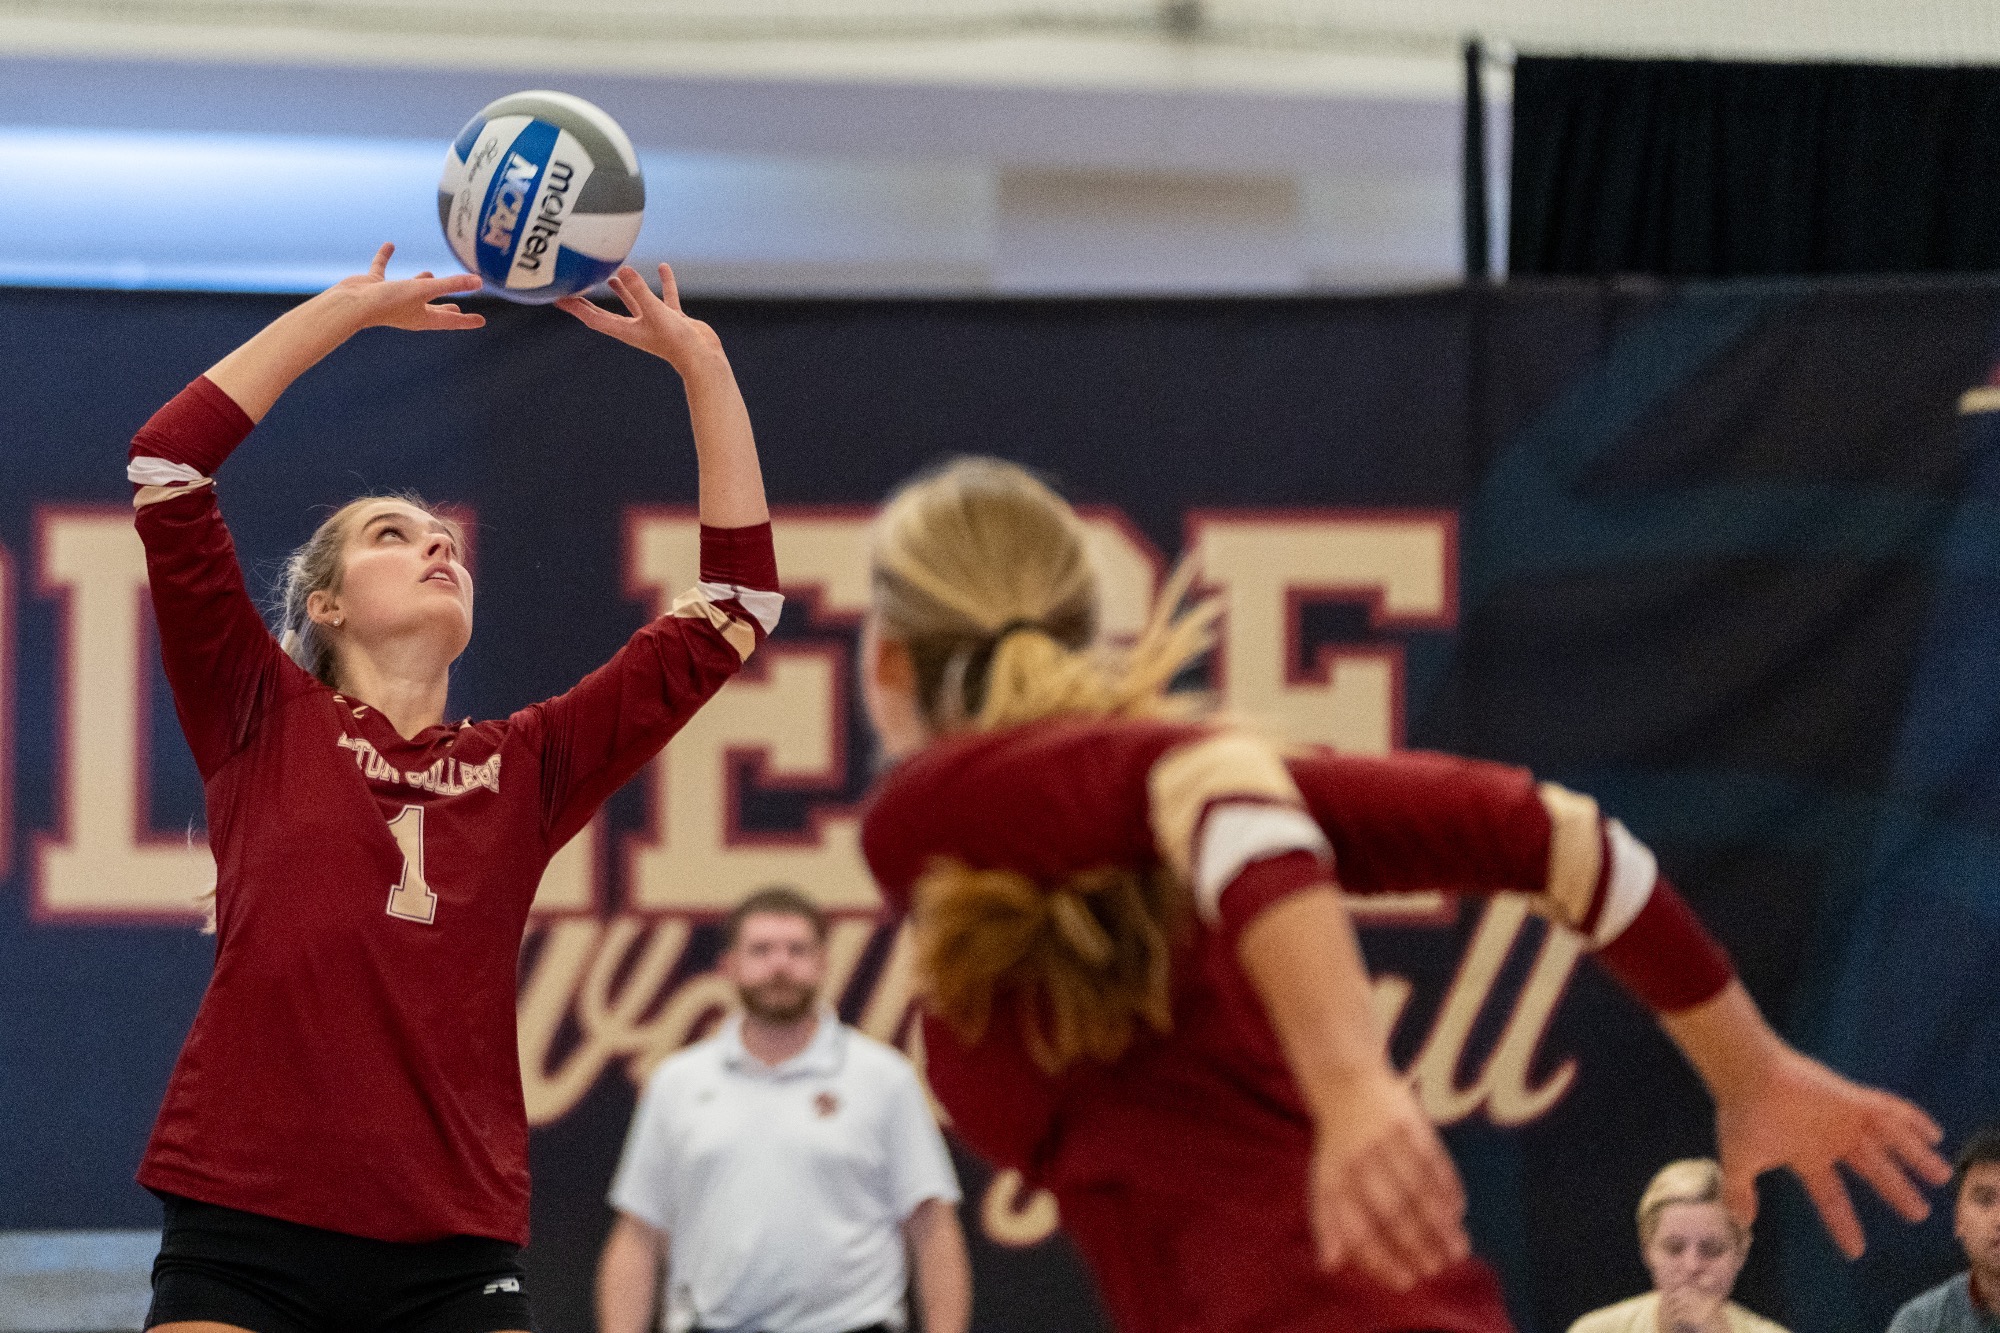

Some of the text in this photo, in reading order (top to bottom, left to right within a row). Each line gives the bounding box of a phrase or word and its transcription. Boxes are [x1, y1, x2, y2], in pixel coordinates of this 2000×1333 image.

[483, 151, 539, 253] NCAA
[516, 160, 574, 271] molten
[386, 804, 438, 925] 1
